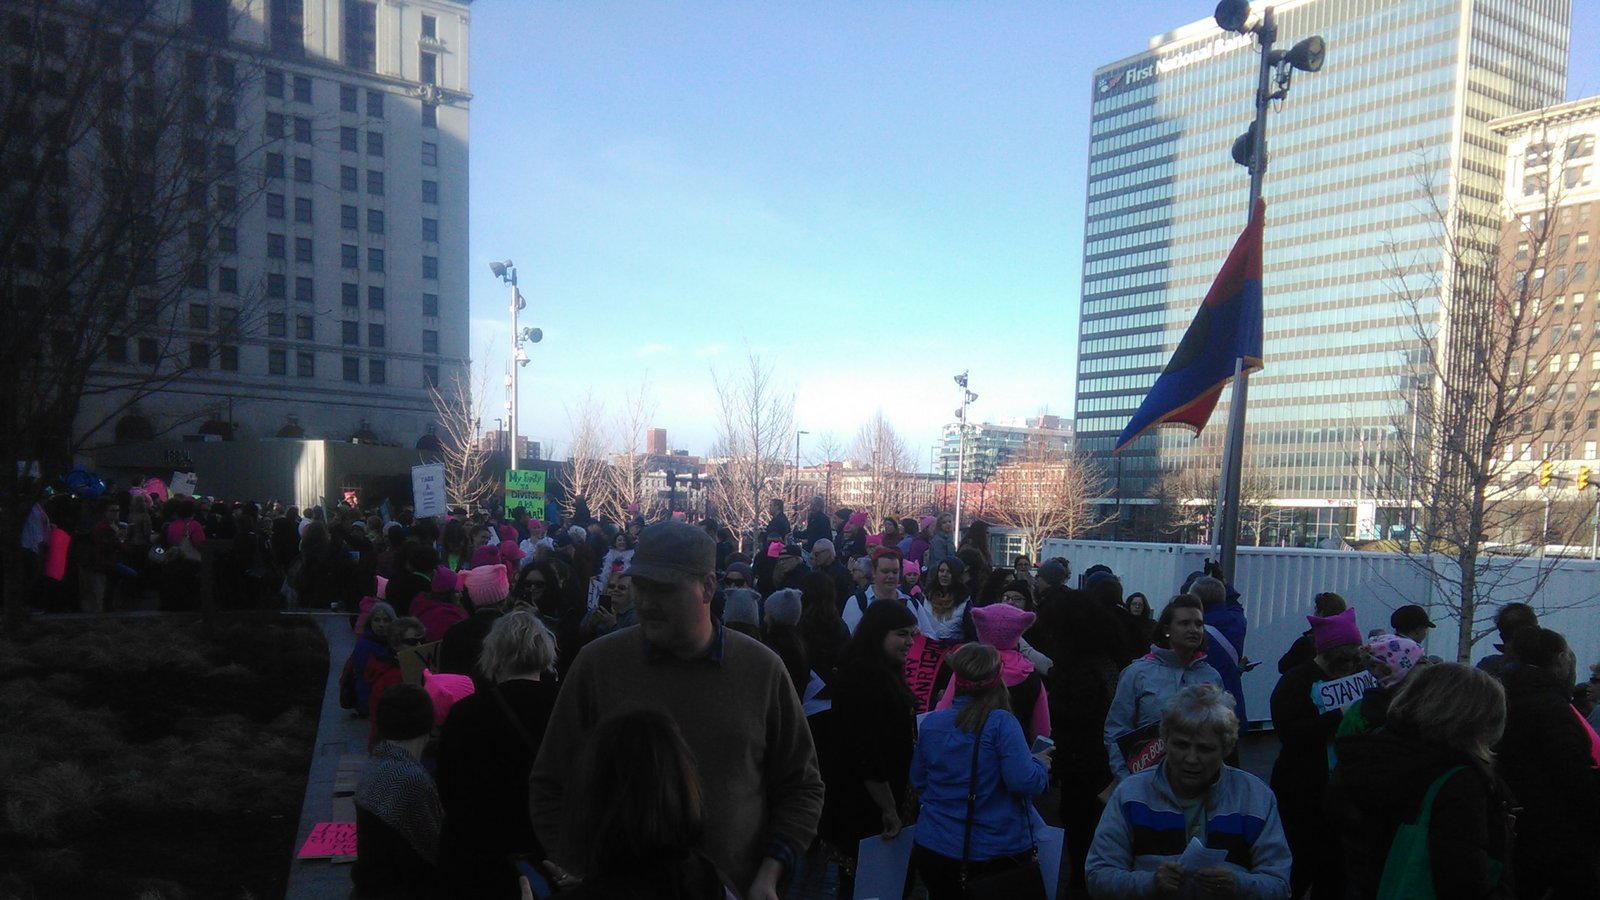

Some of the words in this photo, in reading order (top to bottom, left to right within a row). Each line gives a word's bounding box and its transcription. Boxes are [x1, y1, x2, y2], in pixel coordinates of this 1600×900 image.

[1126, 63, 1153, 85] First
[1156, 41, 1213, 75] National
[1132, 753, 1151, 773] OUR
